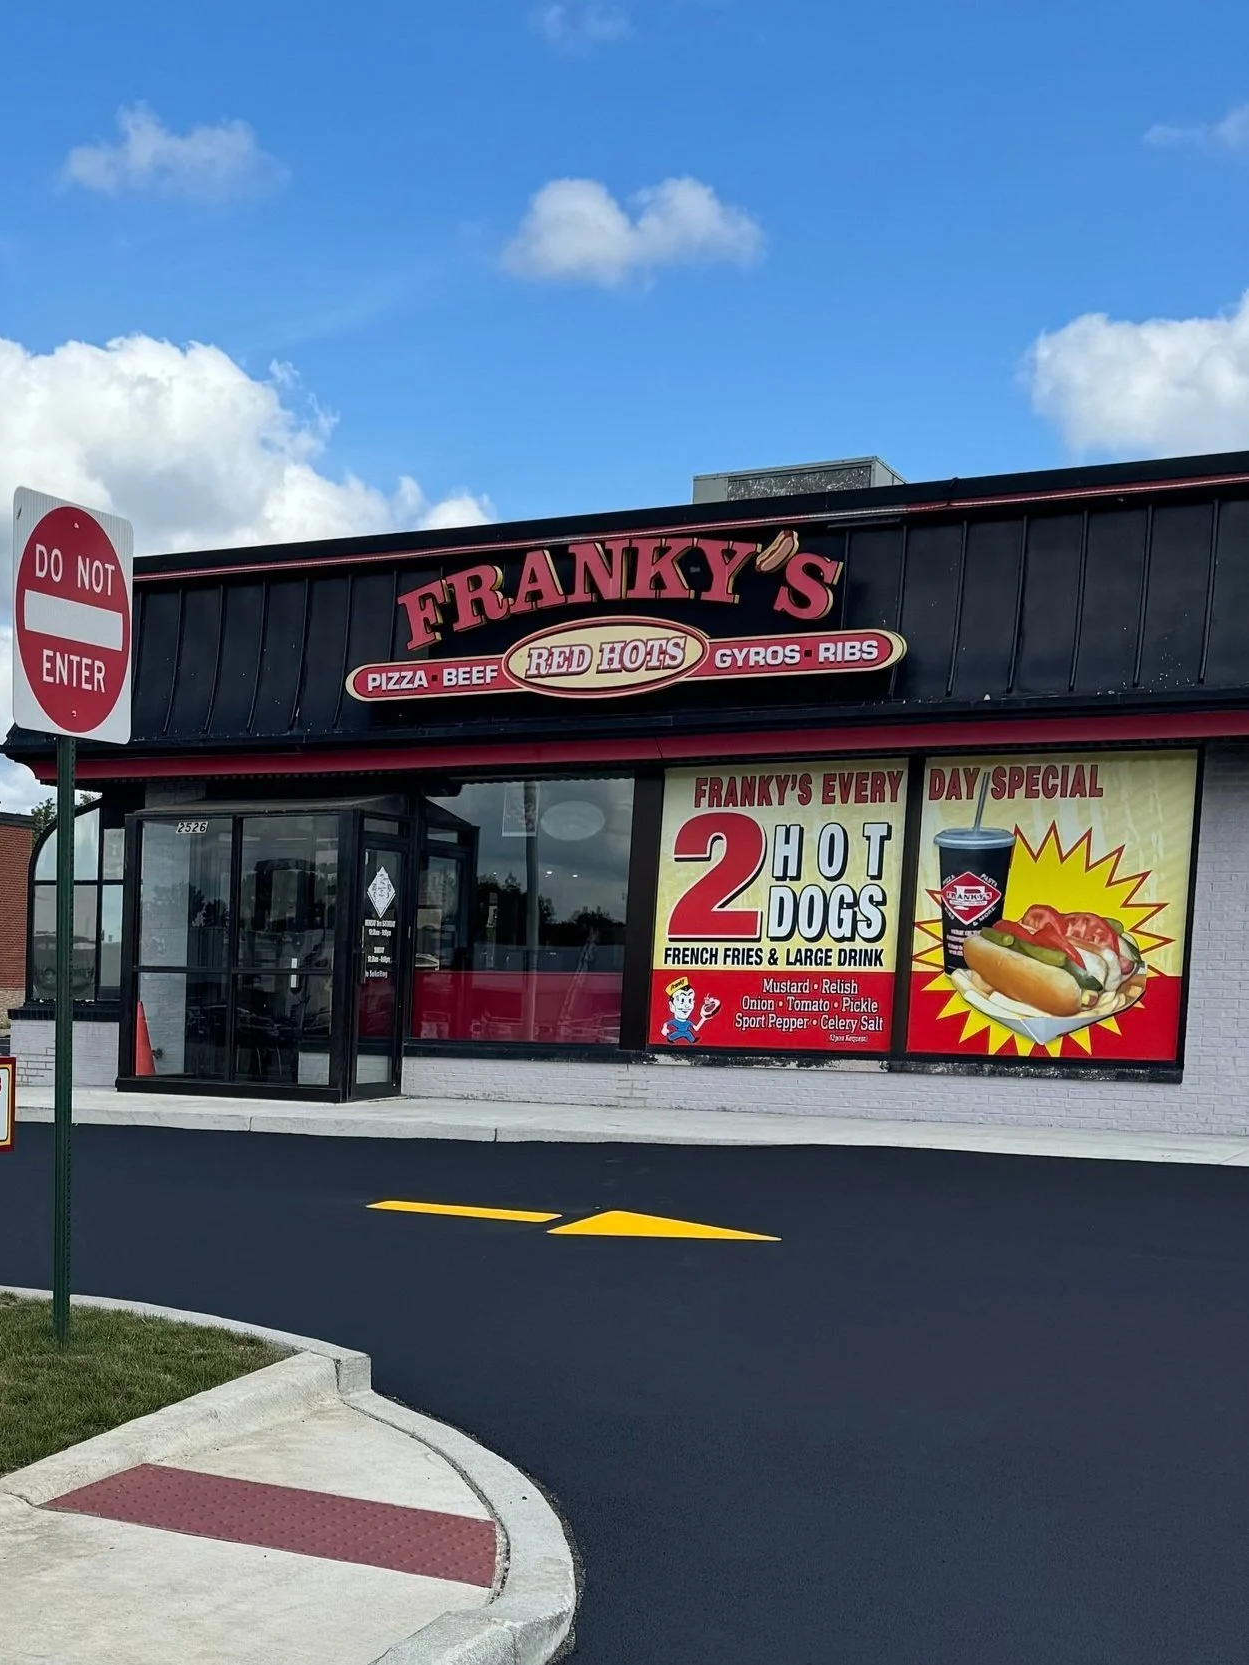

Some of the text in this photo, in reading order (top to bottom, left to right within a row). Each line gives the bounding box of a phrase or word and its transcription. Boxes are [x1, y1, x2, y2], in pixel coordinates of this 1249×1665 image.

[35, 543, 115, 596] DO NOT
[397, 530, 842, 651] FRANKY'S
[42, 649, 105, 693] ENTER
[525, 636, 687, 678] RED HOTS
[714, 640, 878, 669] GYROS RIBS
[367, 665, 498, 692] PIZZA BEEF
[694, 764, 1103, 808] FRANKY'S EVERY DAY SPECIAL
[177, 822, 207, 833] 2526
[772, 822, 892, 881] HOT
[667, 812, 767, 941] 2
[767, 883, 888, 942] DOGS
[664, 947, 884, 967] FRENCH FRIES & LARGE DRINK
[742, 997, 878, 1013] Onion Tomato Pickle
[763, 978, 858, 994] Mustard Relish
[735, 1013, 884, 1033] Sport Pepper Celery Salt
